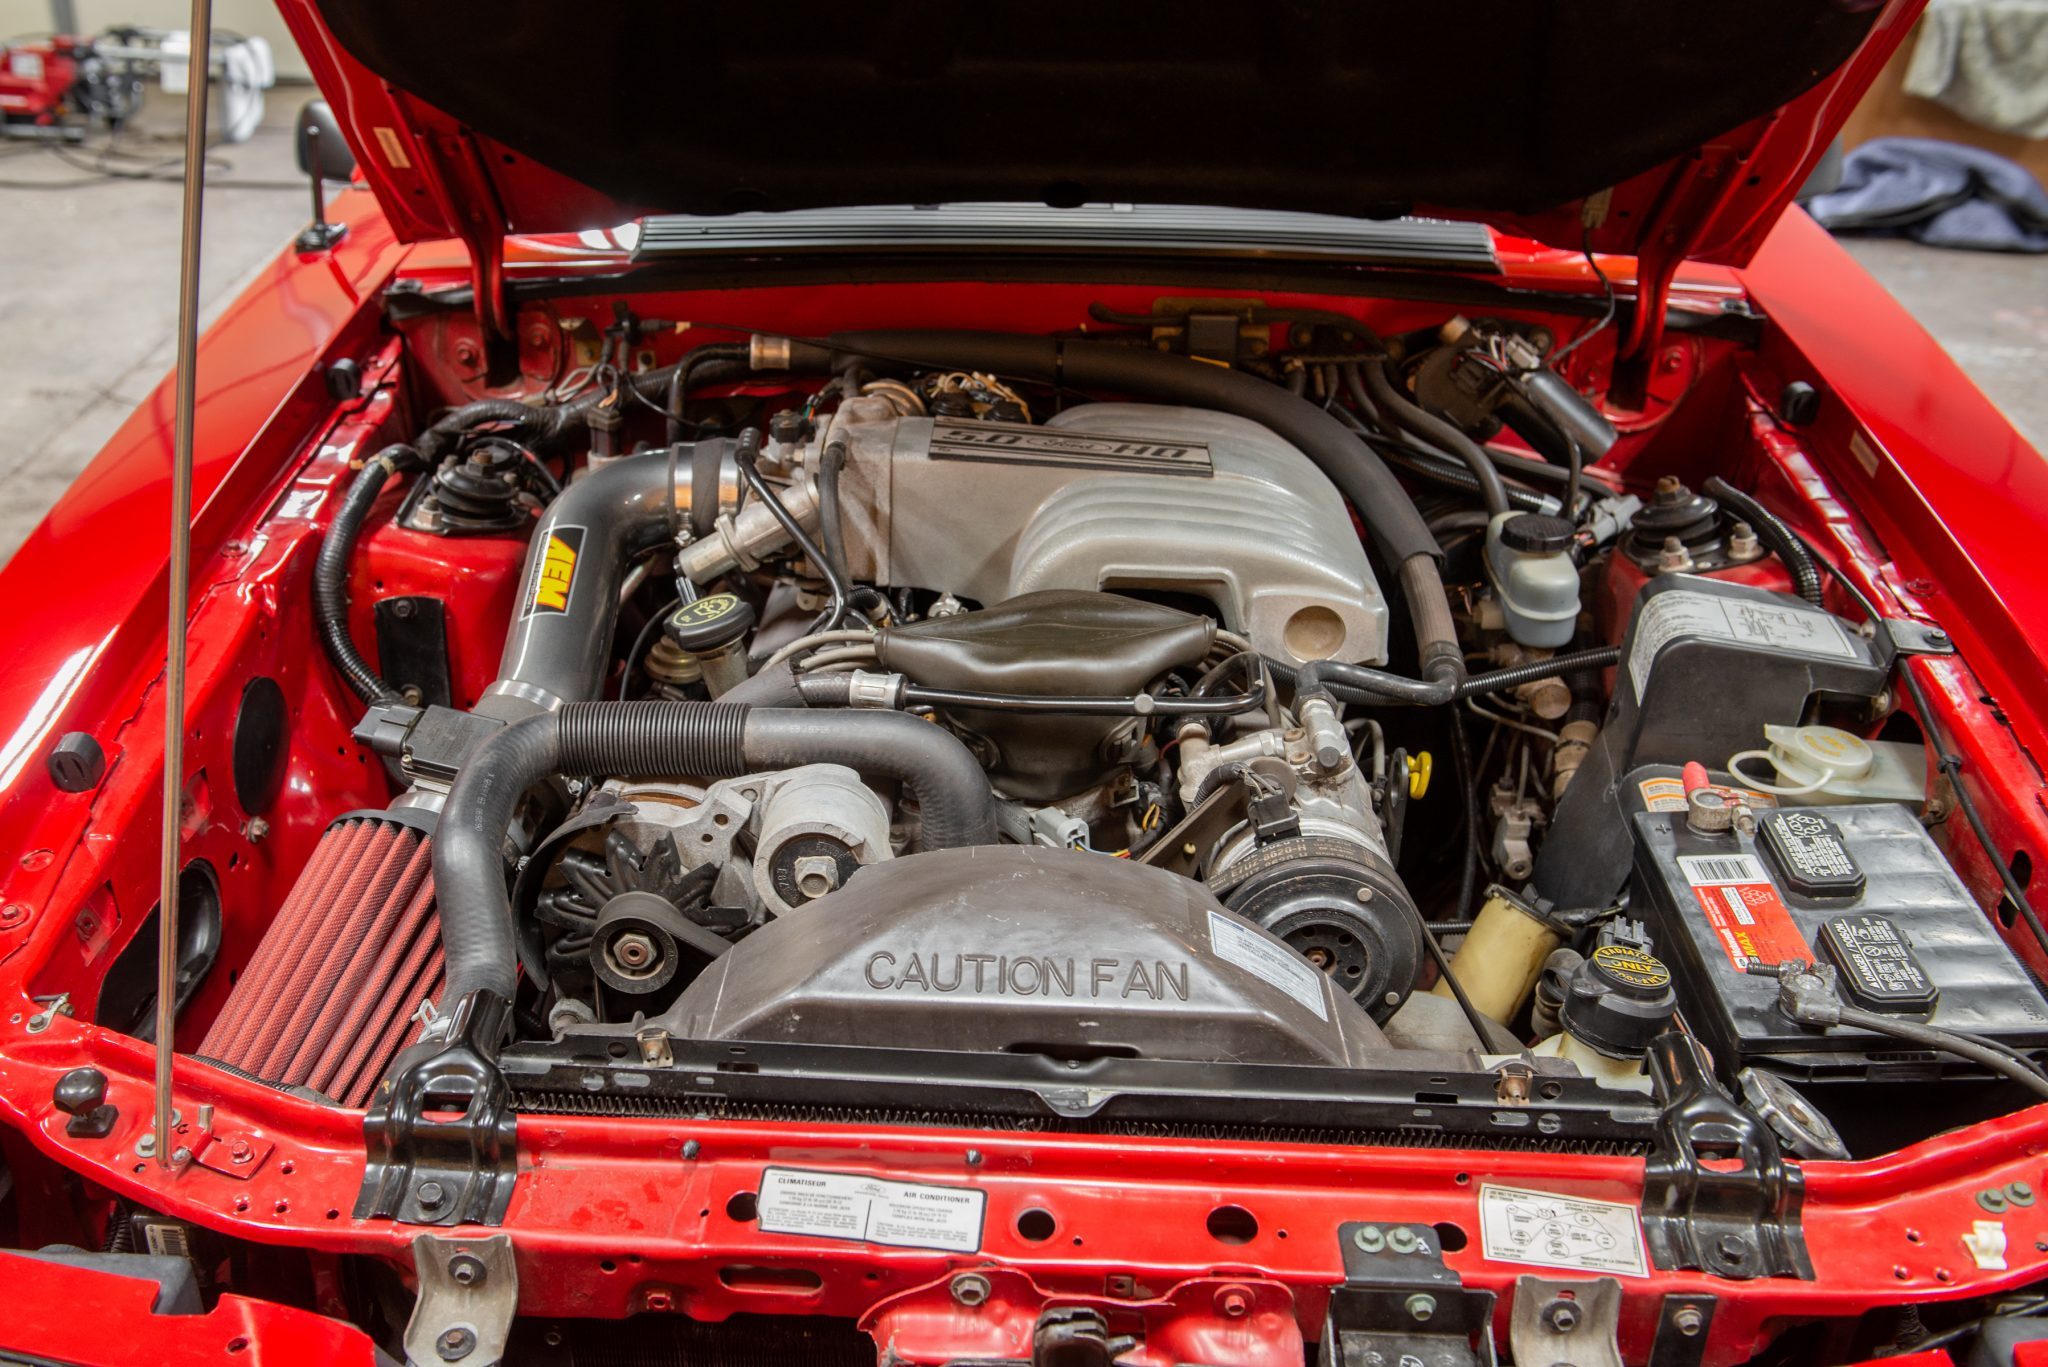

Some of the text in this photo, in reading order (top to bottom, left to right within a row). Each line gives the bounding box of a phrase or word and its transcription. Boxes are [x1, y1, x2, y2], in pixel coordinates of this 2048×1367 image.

[942, 429, 1023, 446] 5.0
[536, 533, 578, 612] AEM
[1734, 931, 1758, 957] MAX
[1834, 923, 1857, 948] POISON
[1601, 947, 1656, 965] RADIATOR
[1611, 960, 1652, 972] ONLY
[1852, 953, 1877, 982] DANGER
[864, 950, 1075, 998] CAUTION
[1091, 957, 1189, 1001] FAN
[1610, 968, 1662, 985] COOLANT
[778, 1177, 827, 1188] CLIMATISEUR
[904, 1191, 970, 1204] AIR CONDITIONER
